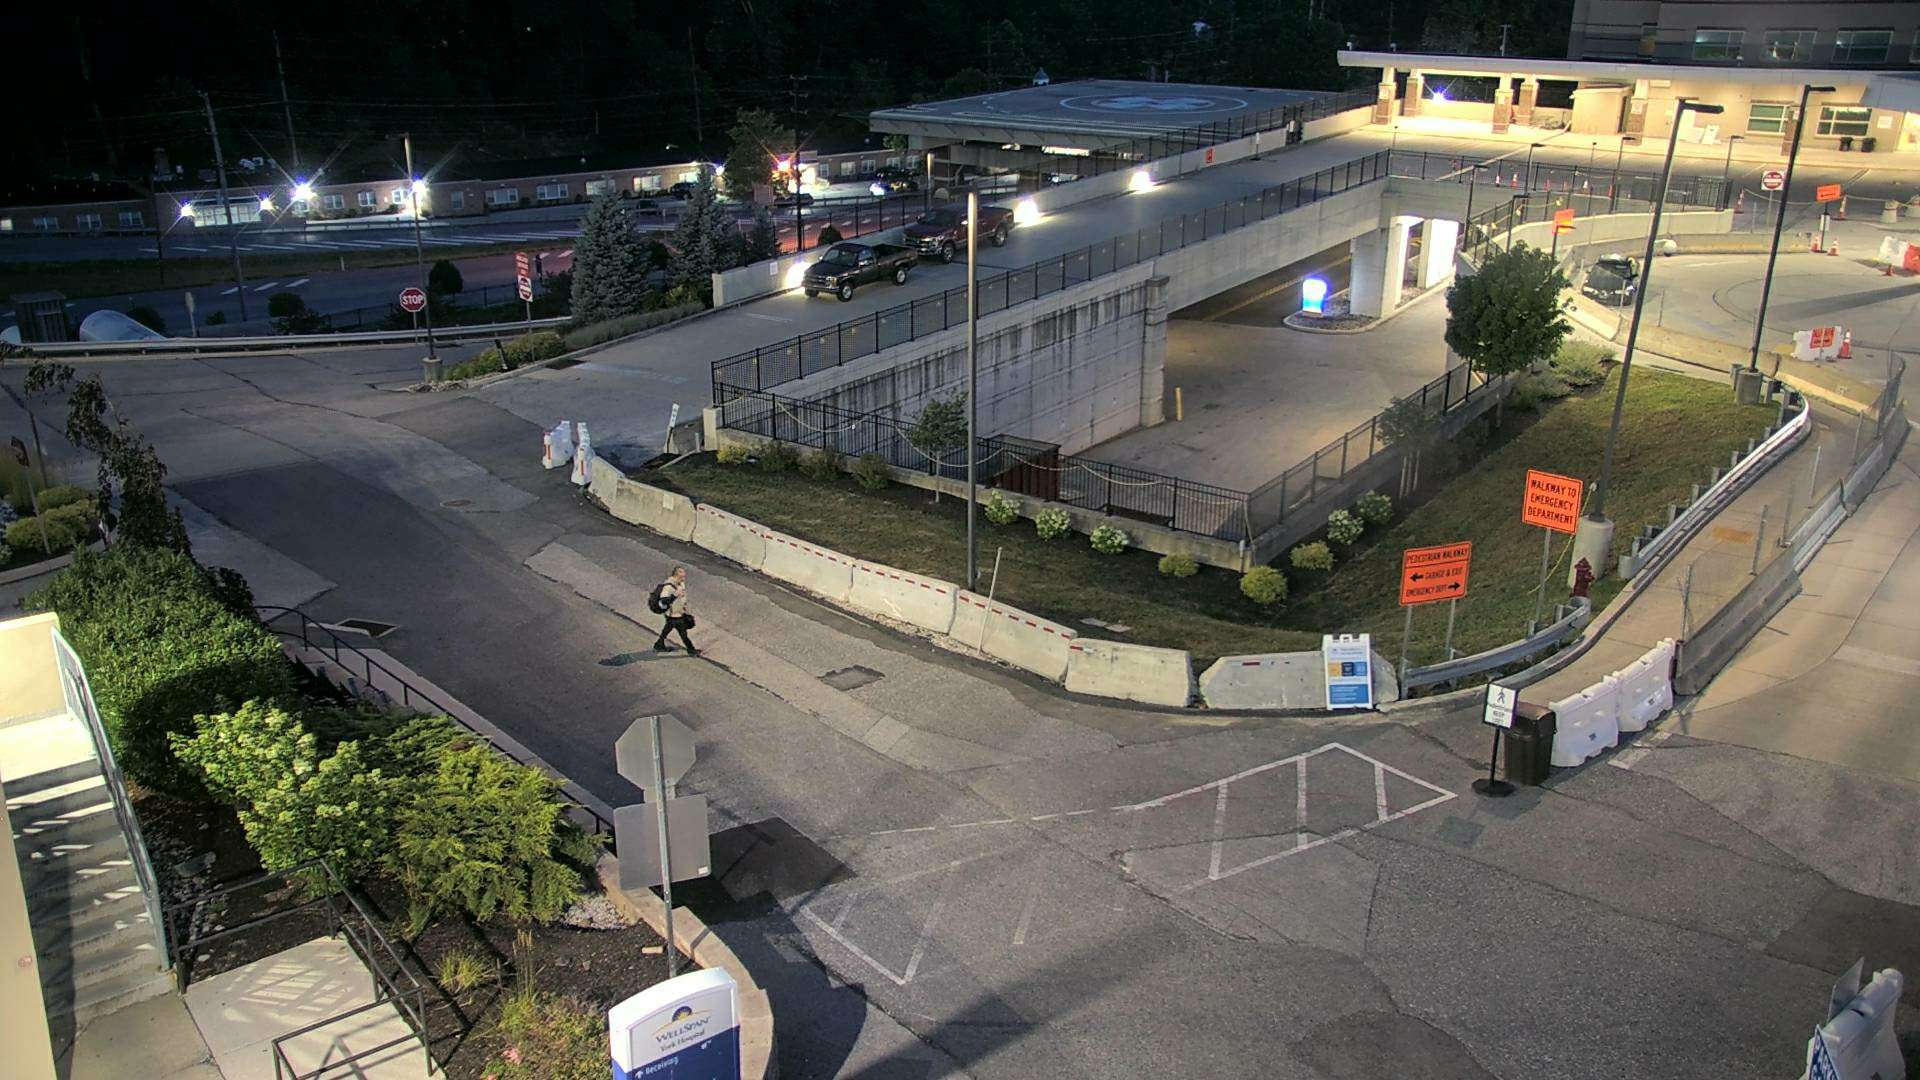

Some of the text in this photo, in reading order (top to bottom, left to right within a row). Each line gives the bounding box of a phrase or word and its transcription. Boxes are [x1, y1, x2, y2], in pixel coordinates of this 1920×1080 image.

[402, 295, 424, 305] STOP
[1531, 480, 1577, 498] WALKWAY TO
[1531, 493, 1574, 511] EMERGENCY
[1528, 505, 1574, 524] DEPARTMENT
[1443, 548, 1467, 558] WALKWAY
[645, 1057, 679, 1074] Receiving
